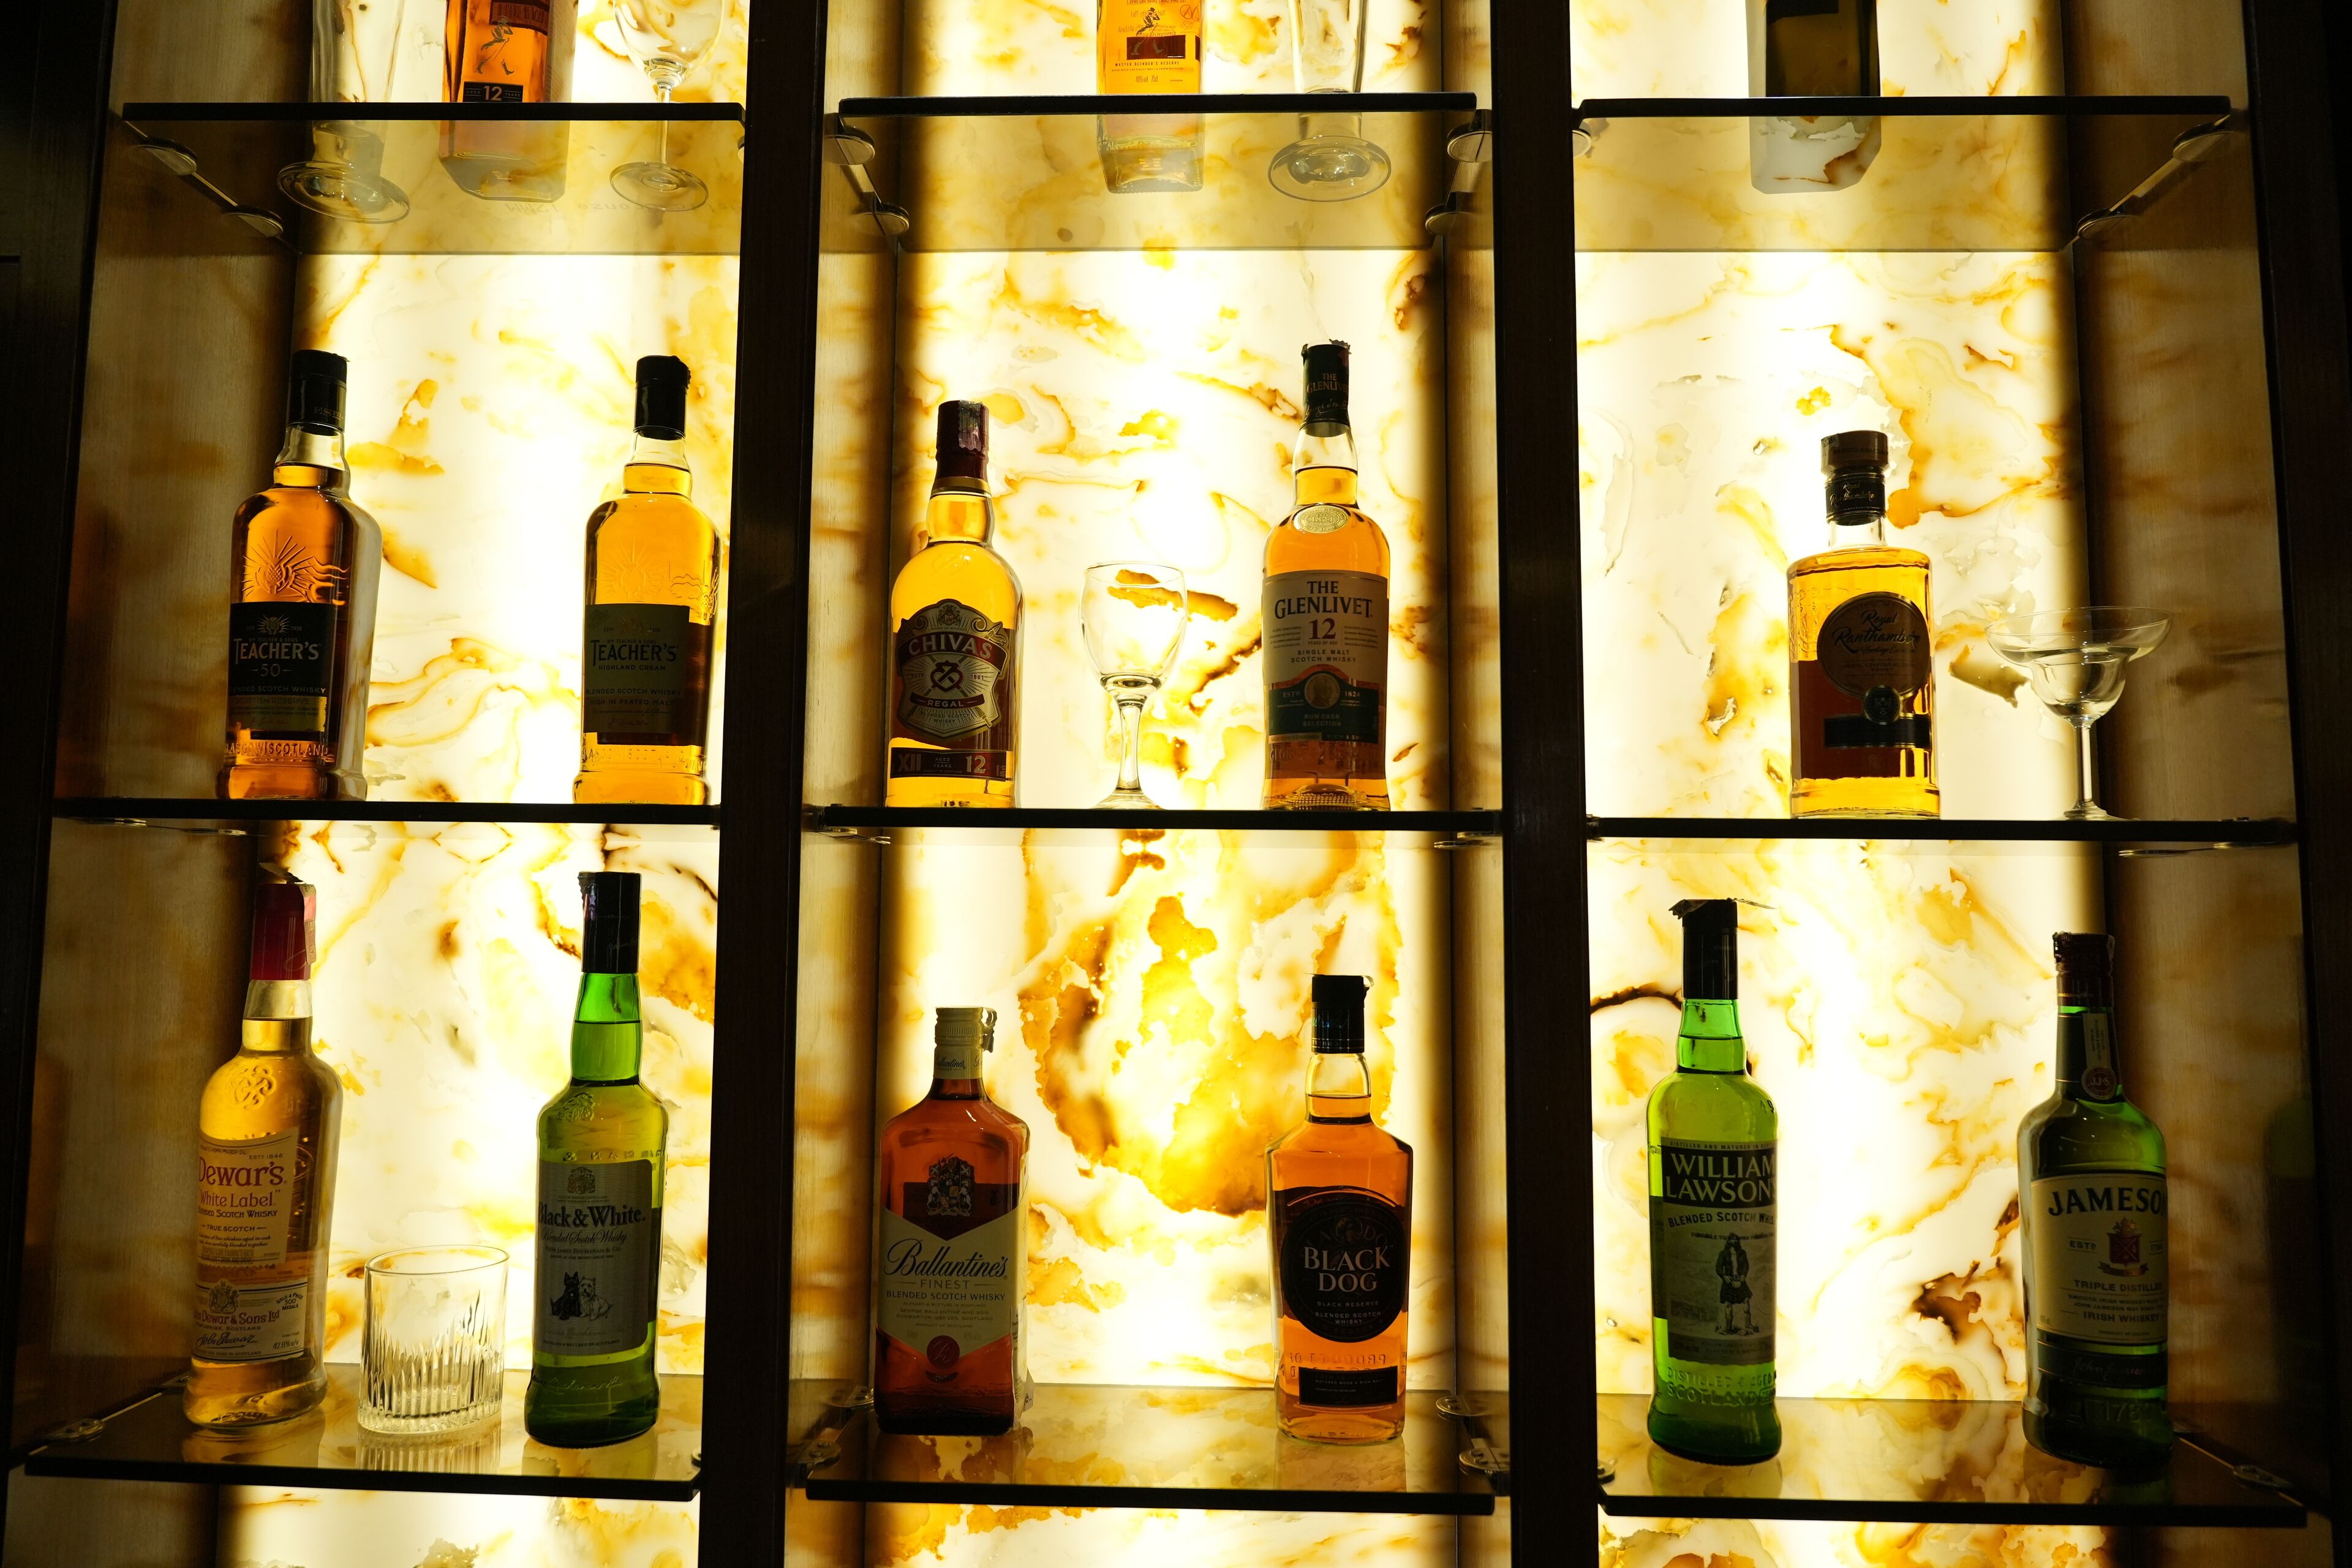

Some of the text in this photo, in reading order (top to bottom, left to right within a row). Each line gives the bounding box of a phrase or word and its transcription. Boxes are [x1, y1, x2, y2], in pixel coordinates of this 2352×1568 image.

[484, 85, 502, 101] 12
[1306, 381, 1348, 393] GLENLIVE
[1307, 581, 1338, 594] THE
[1309, 618, 1336, 639] 12
[1861, 610, 1898, 631] Royal
[233, 638, 319, 665] TEACHER'S
[590, 640, 677, 666] TEACHER'S
[908, 634, 992, 659] CHIVAS
[260, 663, 281, 677] 50
[898, 753, 921, 772] XII
[965, 755, 986, 774] 12
[198, 1156, 285, 1186] Dewar's
[1670, 1153, 1774, 1178] WILLIAM
[1665, 1175, 1773, 1203] LAWSON
[1668, 1213, 1713, 1228] BLENDED
[1717, 1212, 1755, 1222] SCOTCH
[569, 1231, 596, 1246] Scotch
[595, 1227, 628, 1245] Whisky
[884, 1238, 1008, 1278] Ballantine's
[1303, 1246, 1393, 1272] BLACK
[921, 1279, 970, 1289] FINEST
[1318, 1272, 1378, 1292] DOG
[2073, 1280, 2116, 1291] TRIPLE
[886, 1291, 927, 1299] BLENDED
[202, 1310, 227, 1324] Dewar
[230, 1316, 238, 1325] &
[239, 1313, 266, 1324] Sons
[2083, 1311, 2160, 1323] IRISH WHISKEY
